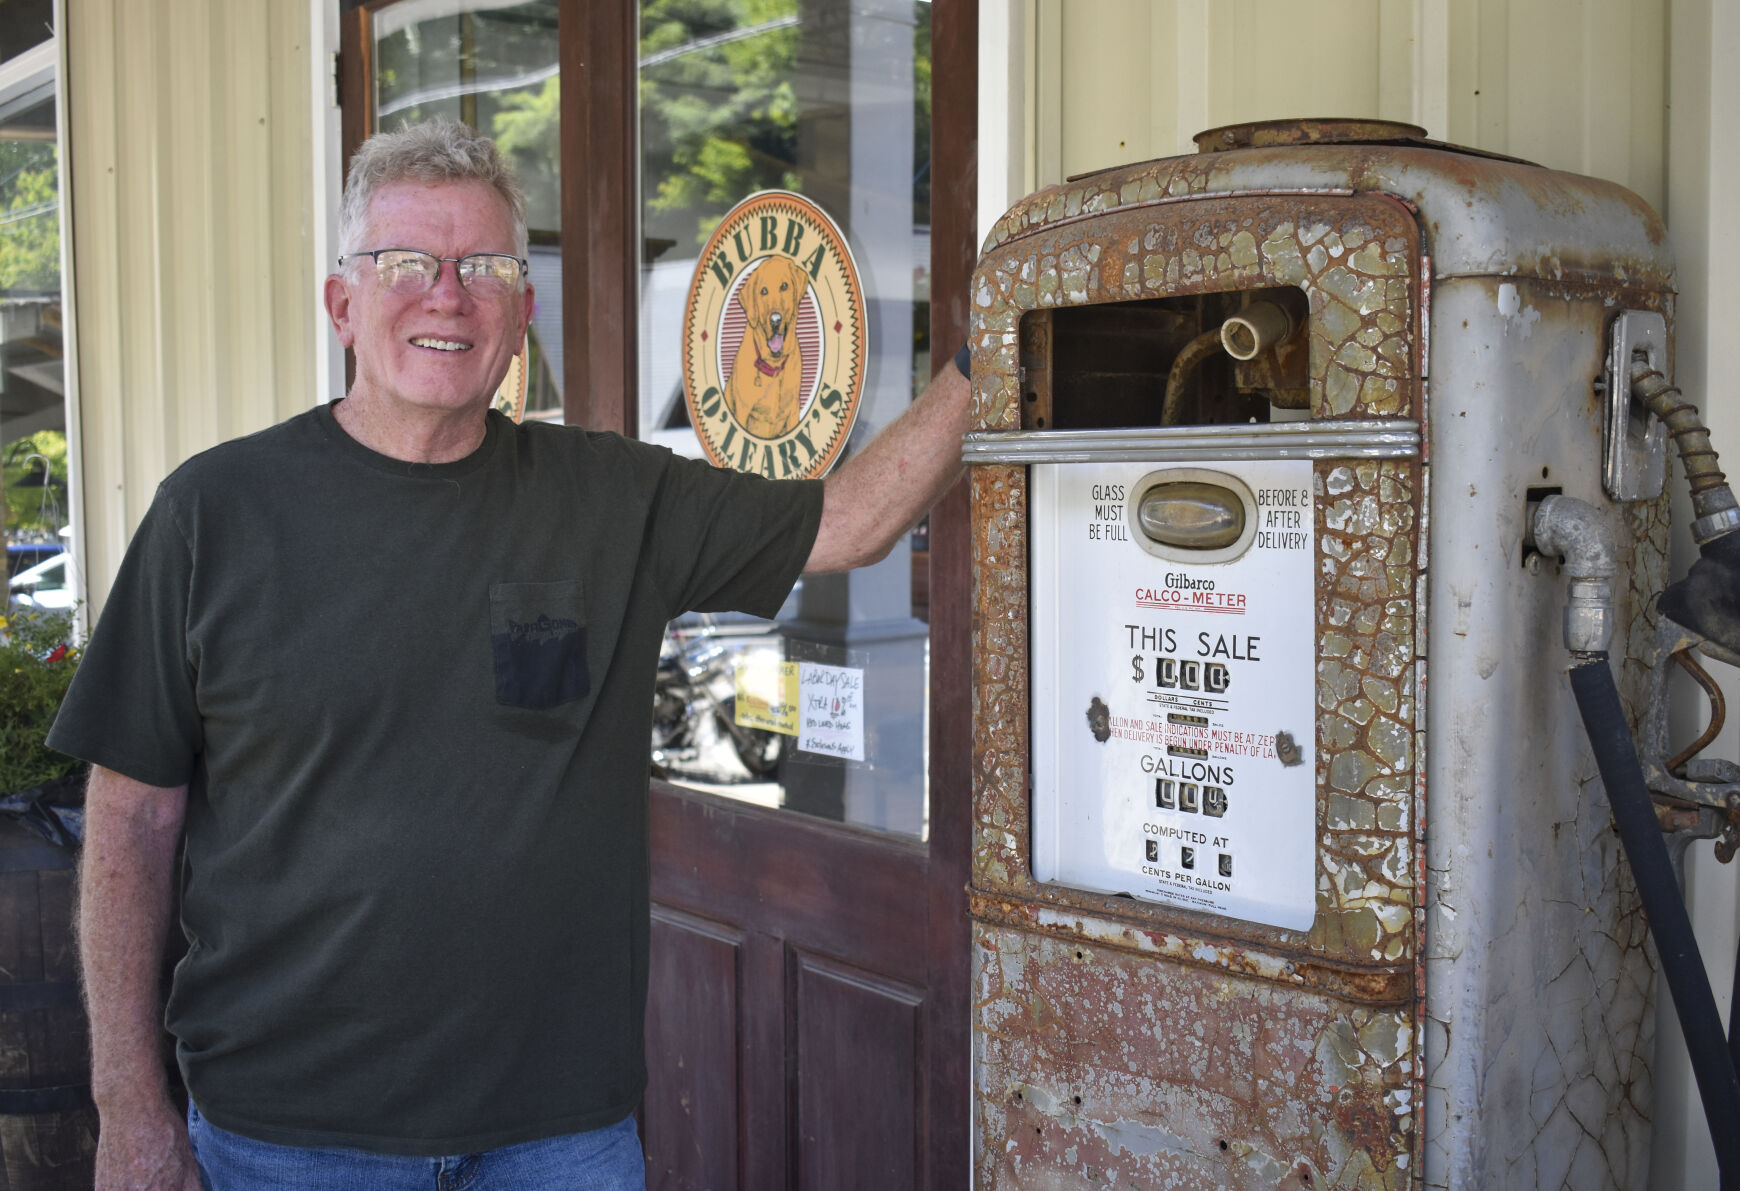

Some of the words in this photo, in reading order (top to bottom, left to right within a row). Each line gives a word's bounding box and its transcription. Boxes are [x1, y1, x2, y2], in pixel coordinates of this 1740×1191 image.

[711, 215, 826, 290] BUBBA
[702, 382, 843, 480] O'LEARY'S
[1092, 484, 1125, 501] GLASS
[1258, 489, 1298, 506] BEFORE
[1095, 505, 1124, 521] MUST
[1266, 511, 1301, 529] AFTER
[1089, 524, 1102, 540] BE
[1105, 525, 1128, 542] FULL
[1258, 531, 1308, 550] DELIVERY
[1165, 572, 1215, 591] Gilbarco
[1125, 624, 1177, 653] THIS
[1197, 632, 1260, 661] SALE
[1154, 694, 1178, 703] DOLLARS
[1193, 699, 1213, 707] CENTS
[1108, 715, 1129, 728] ALLON
[1130, 719, 1143, 731] AND
[1145, 720, 1163, 733] SALE
[1165, 723, 1208, 739] INDICATIONS
[1211, 730, 1232, 742] MUST
[1234, 732, 1244, 744] BE
[1245, 733, 1255, 745] AT
[1110, 727, 1123, 739] HEN
[1124, 730, 1155, 744] DELIVERY
[1156, 733, 1163, 745] IS
[1165, 735, 1187, 749] BEGUN
[1189, 738, 1212, 752] UNDER
[1215, 742, 1248, 757] PENALTY
[1251, 745, 1260, 757] OF
[1263, 747, 1276, 759] LA
[1141, 754, 1234, 785] GALLONS
[1143, 822, 1207, 844] COMPUTED
[1213, 836, 1229, 849] AT
[1142, 865, 1171, 879] CENTS
[1175, 872, 1192, 884] PER
[1195, 877, 1231, 892] GALLON
